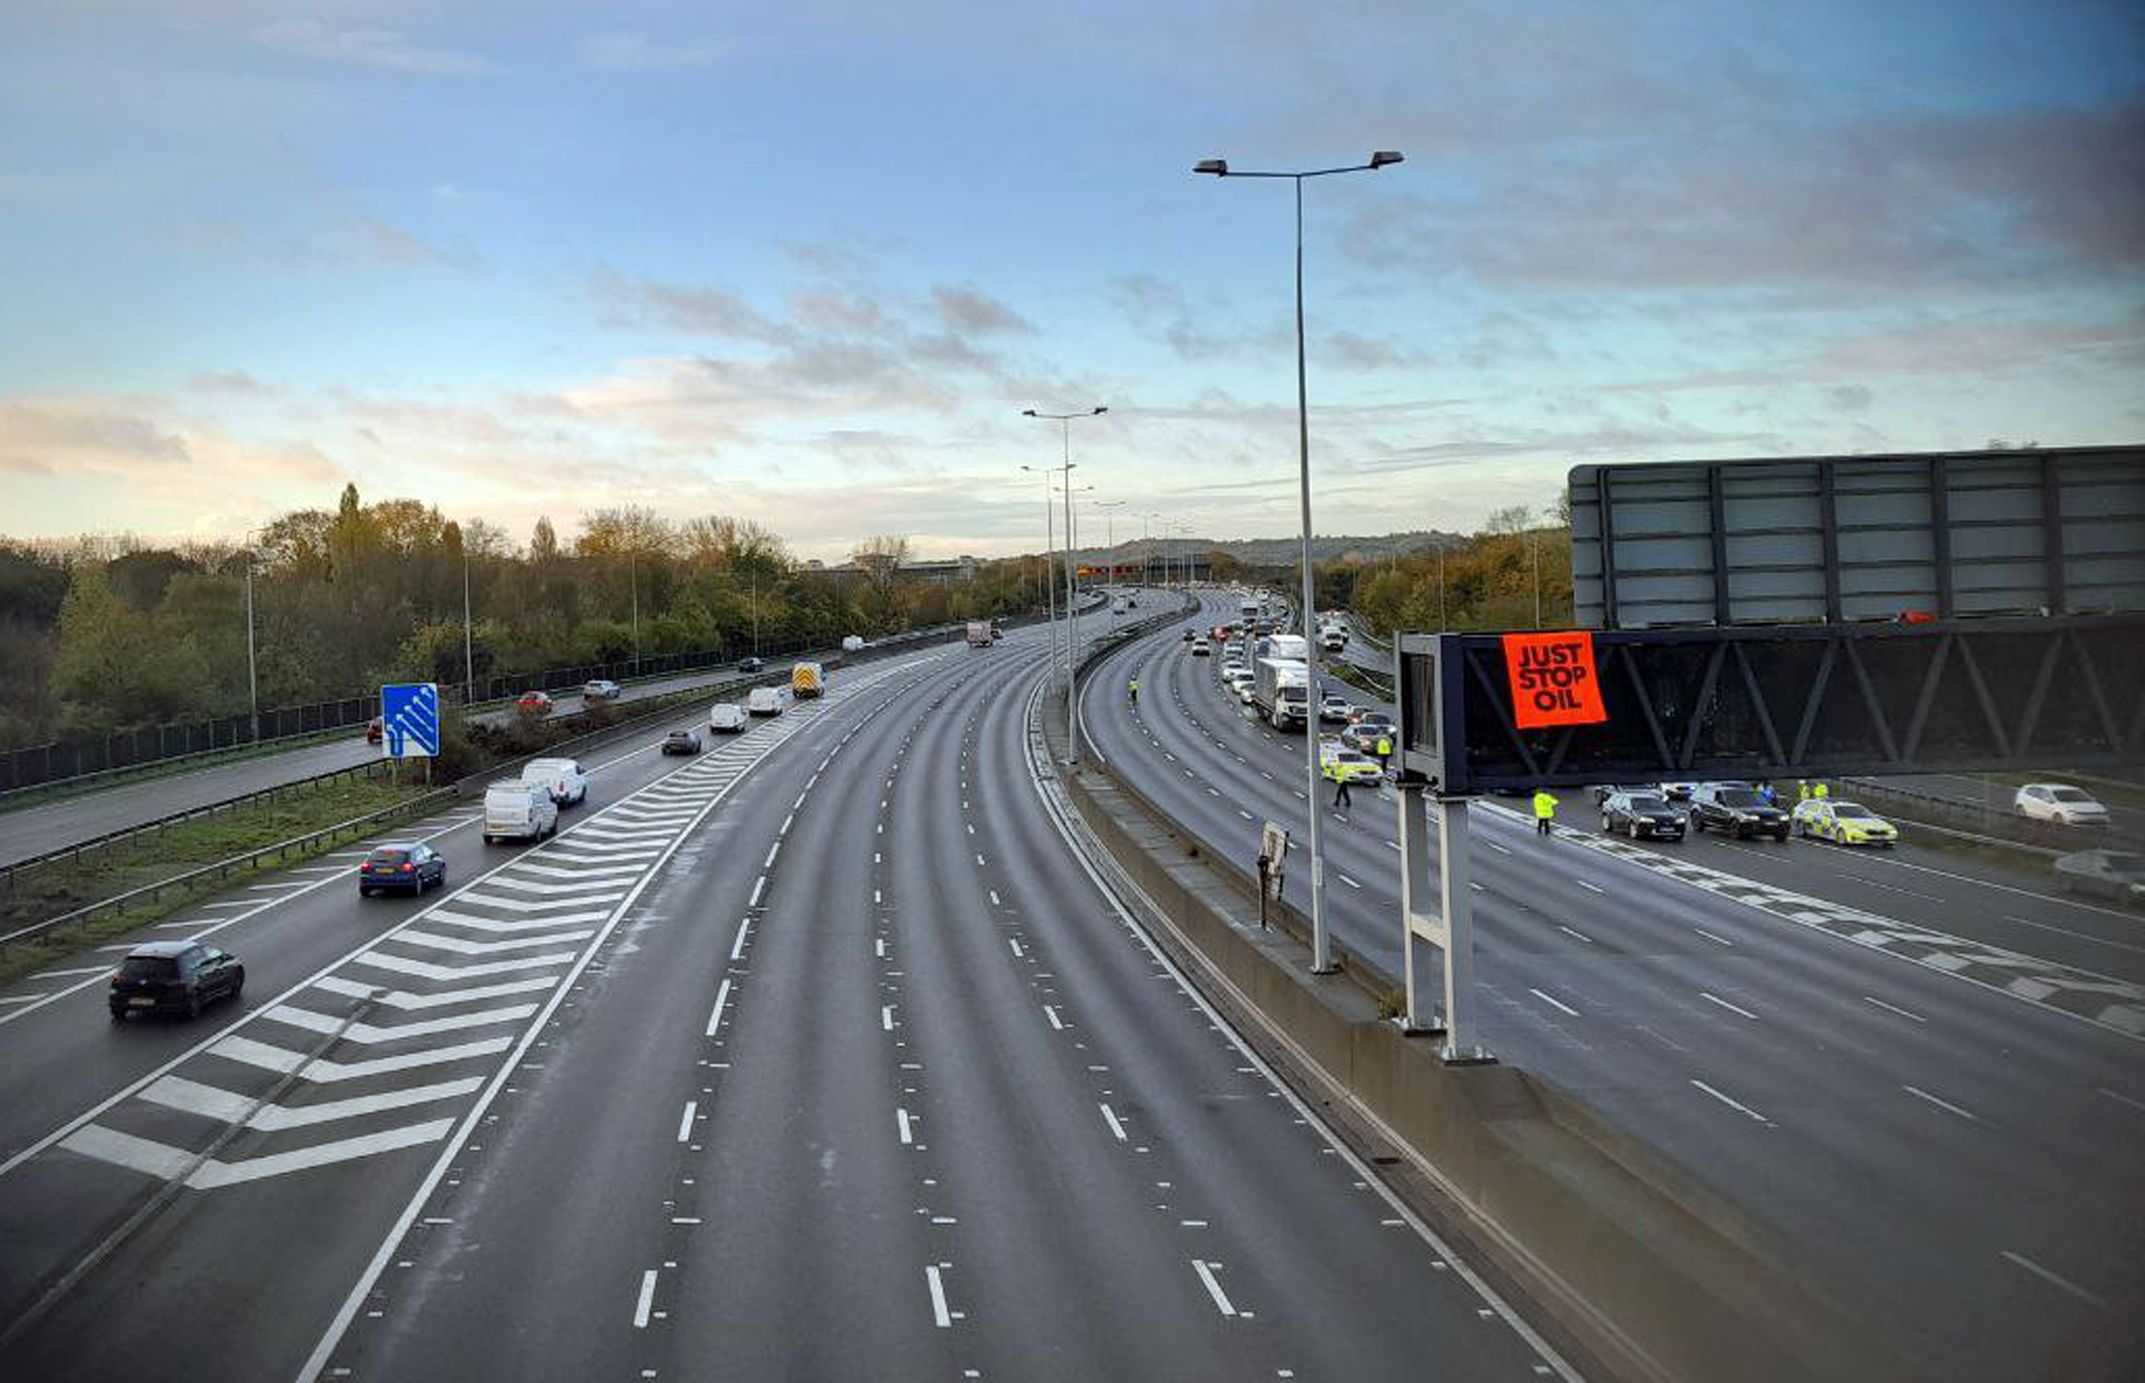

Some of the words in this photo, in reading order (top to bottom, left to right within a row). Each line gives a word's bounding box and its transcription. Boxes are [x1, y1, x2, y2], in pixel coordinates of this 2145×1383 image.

[1517, 643, 1583, 667] JUST
[1519, 666, 1587, 690] STOP
[1534, 689, 1583, 711] OIL
